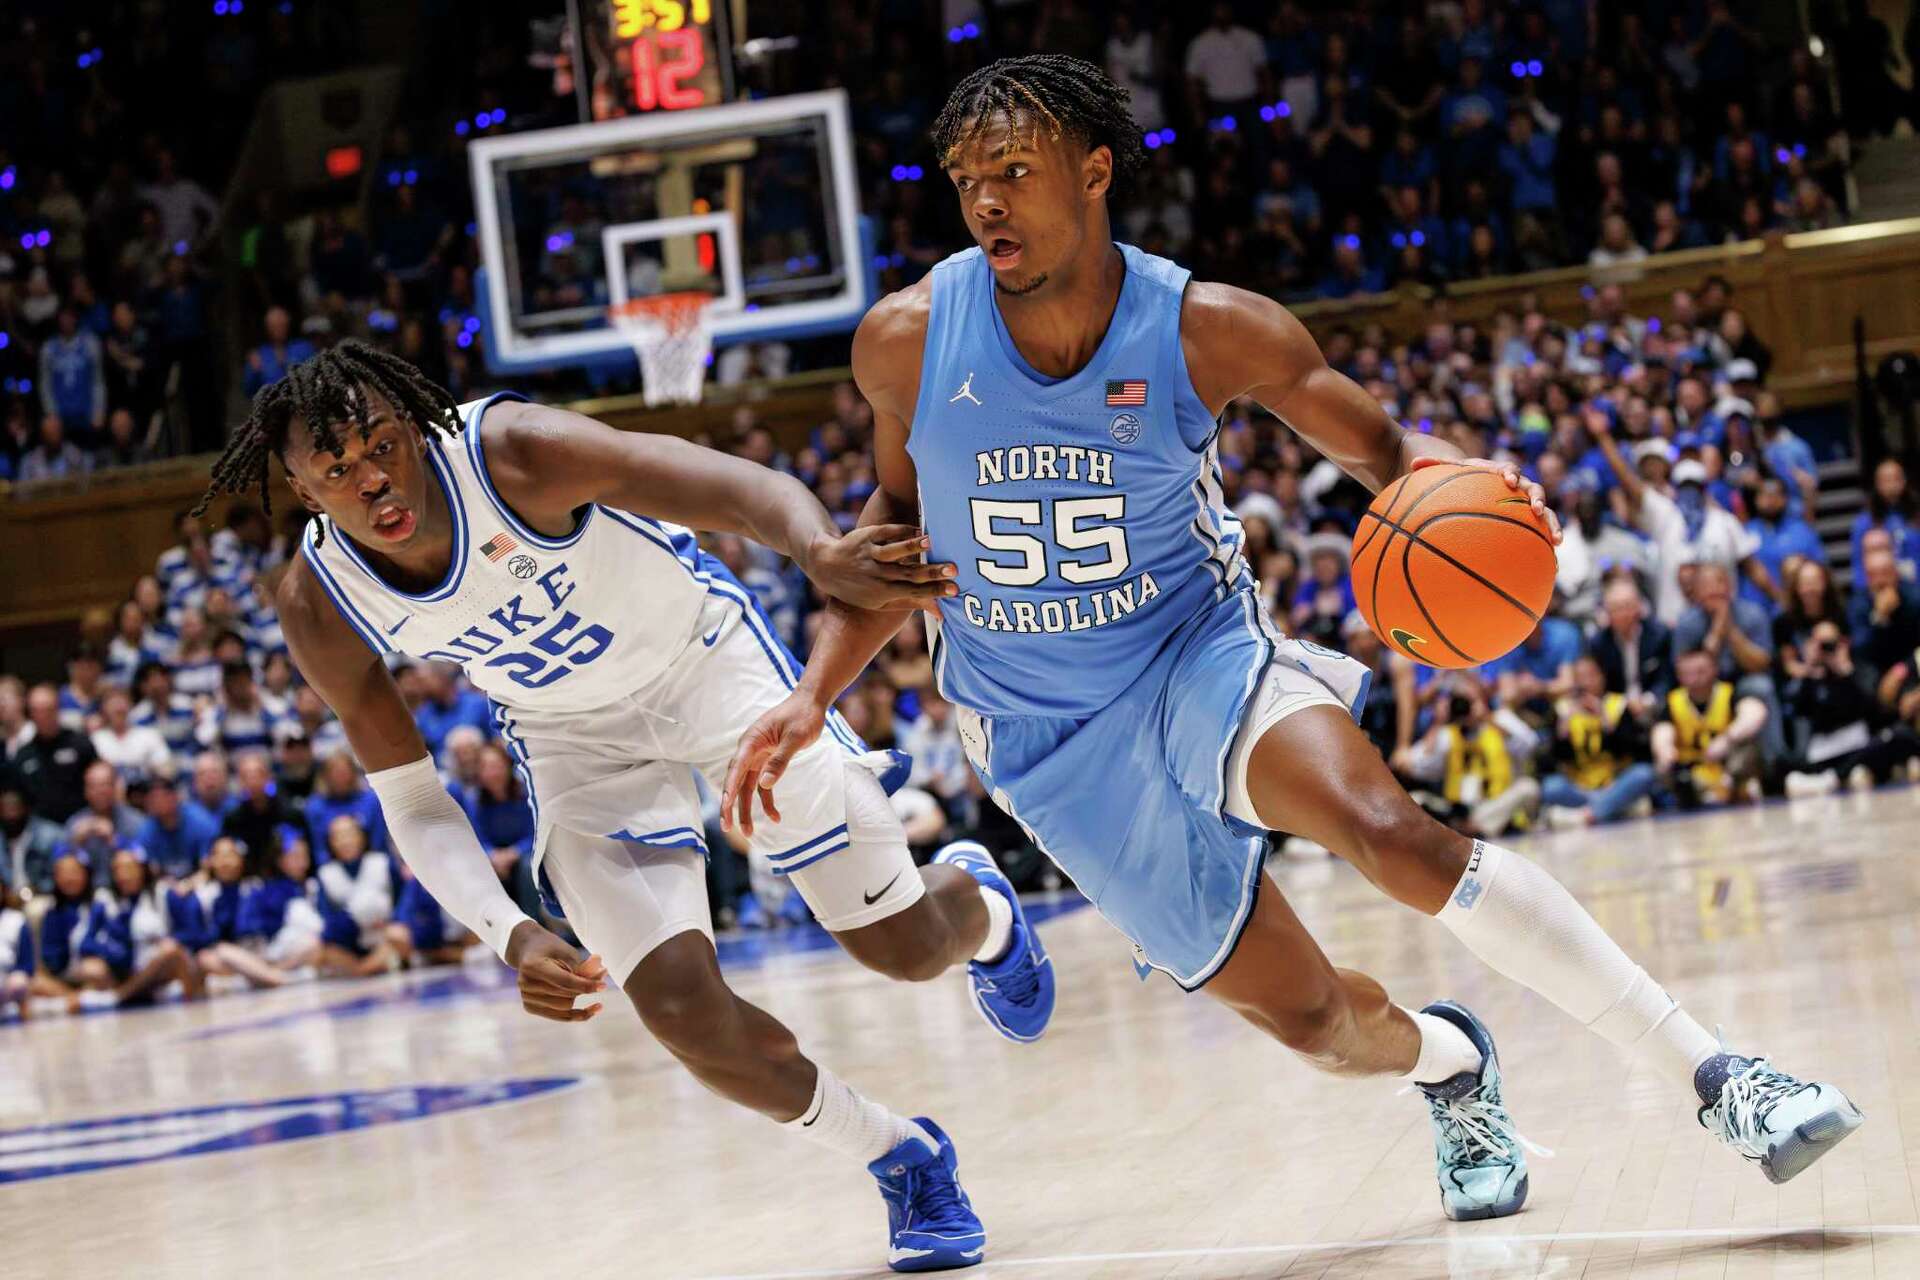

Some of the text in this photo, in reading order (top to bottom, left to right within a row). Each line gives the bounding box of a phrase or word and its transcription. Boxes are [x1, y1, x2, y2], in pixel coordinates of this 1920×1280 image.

[632, 27, 704, 110] 12
[975, 445, 1114, 487] NORTH
[968, 494, 1131, 587] 55
[963, 572, 1161, 633] CAROLINA
[484, 610, 615, 689] 25
